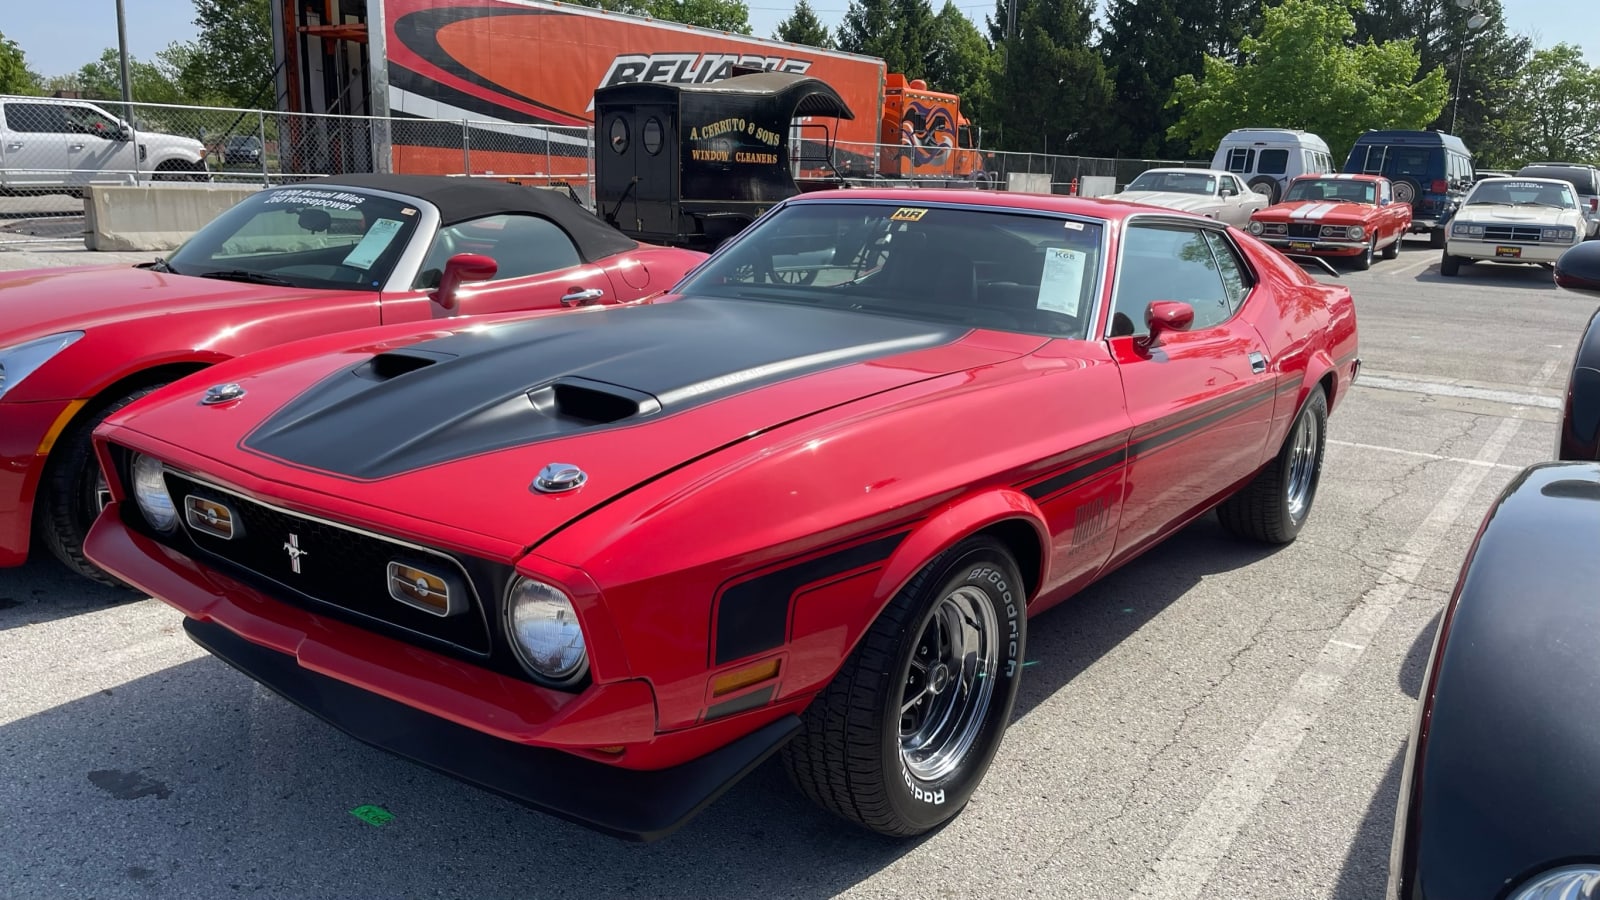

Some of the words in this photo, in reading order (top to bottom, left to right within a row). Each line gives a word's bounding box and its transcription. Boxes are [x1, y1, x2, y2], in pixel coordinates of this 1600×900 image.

[690, 127, 701, 140] A.
[701, 118, 745, 139] CERRUTO
[748, 122, 755, 135] &
[756, 127, 780, 146] SONS
[692, 149, 729, 161] WINDOW
[735, 151, 778, 164] CLEANERS
[284, 196, 357, 211] Horsepower
[300, 190, 336, 199] Actual
[333, 191, 366, 204] Miles
[896, 210, 922, 218] NR
[967, 568, 1018, 678] BFGoodrich
[902, 766, 945, 805] Radial
